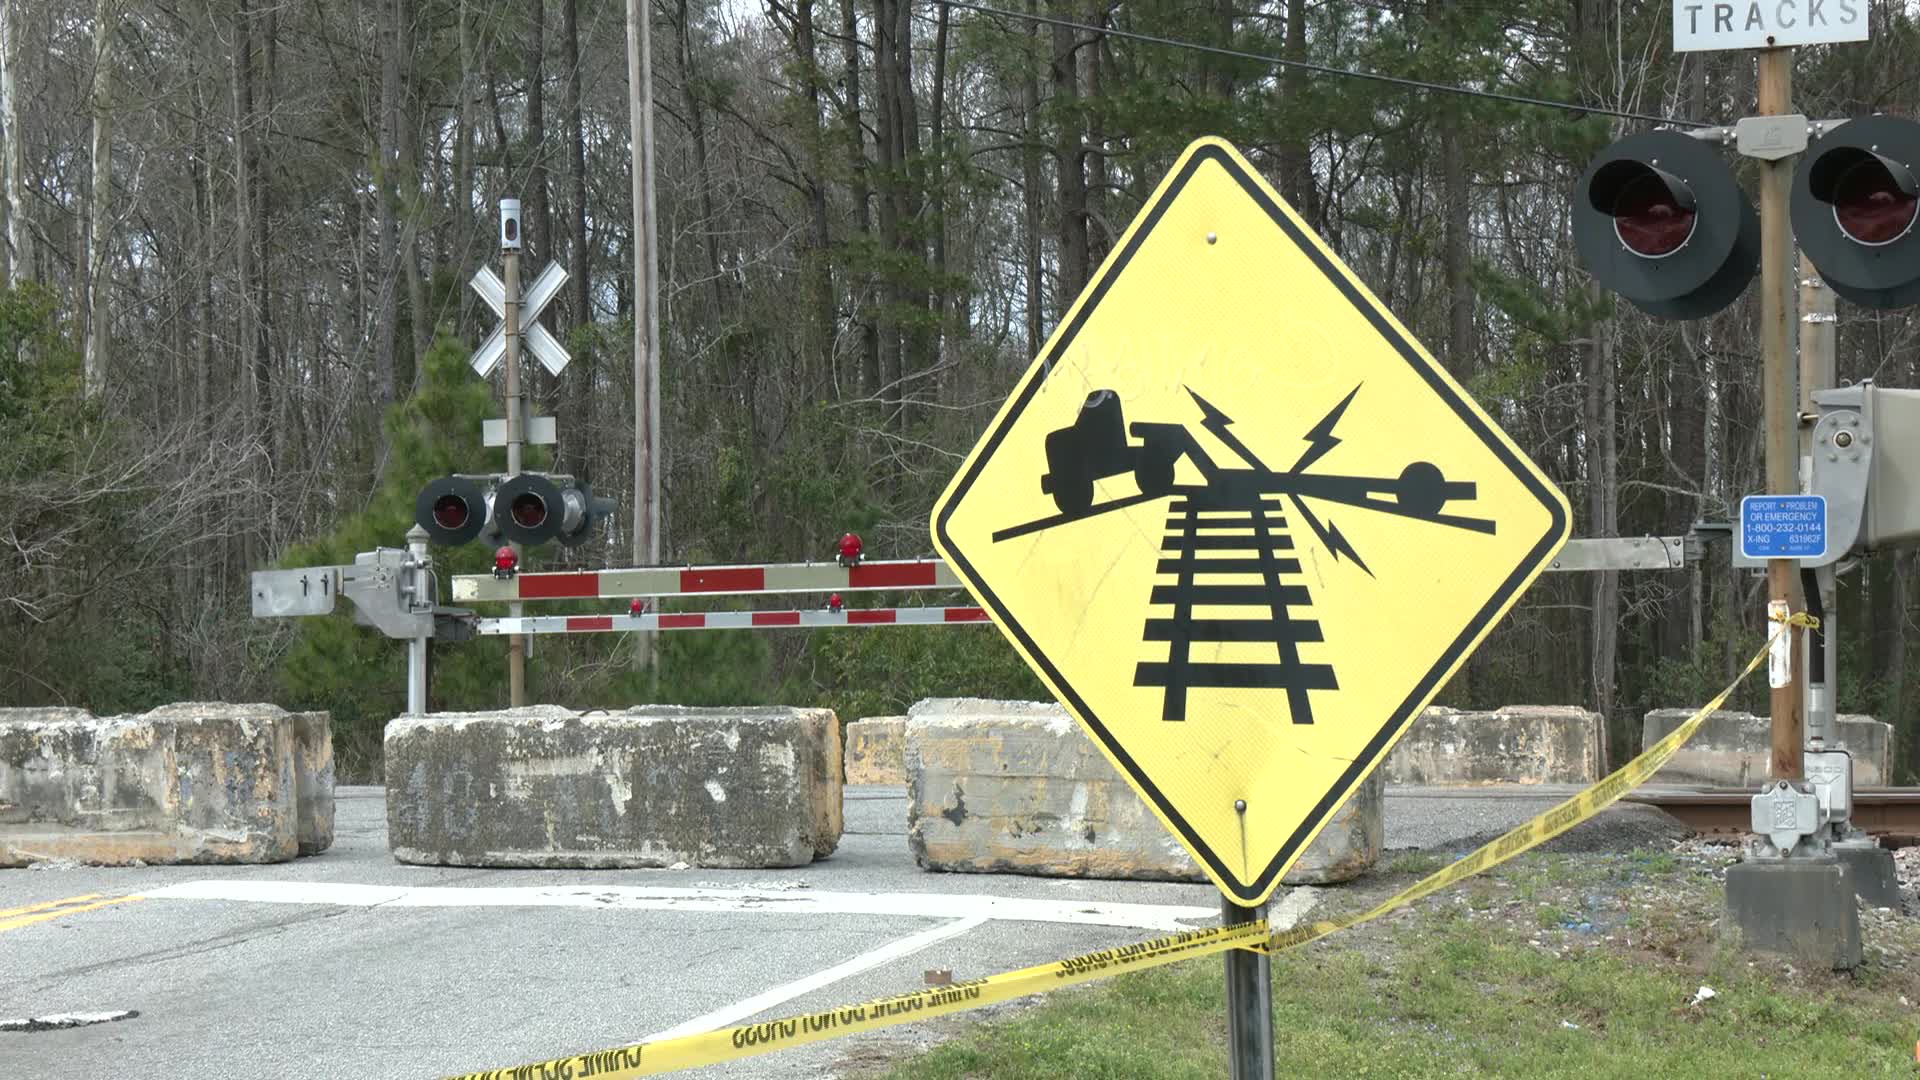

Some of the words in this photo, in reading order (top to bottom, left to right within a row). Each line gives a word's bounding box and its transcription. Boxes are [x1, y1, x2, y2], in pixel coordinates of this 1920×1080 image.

[1684, 0, 1859, 34] TRACKS
[1750, 502, 1777, 511] REPORT
[1787, 502, 1818, 510] PROBLEM
[1750, 513, 1763, 521] OR
[1764, 512, 1817, 521] EMERGENCY
[1747, 523, 1821, 533] 1-800-232-0144
[1747, 534, 1770, 544] X-ING
